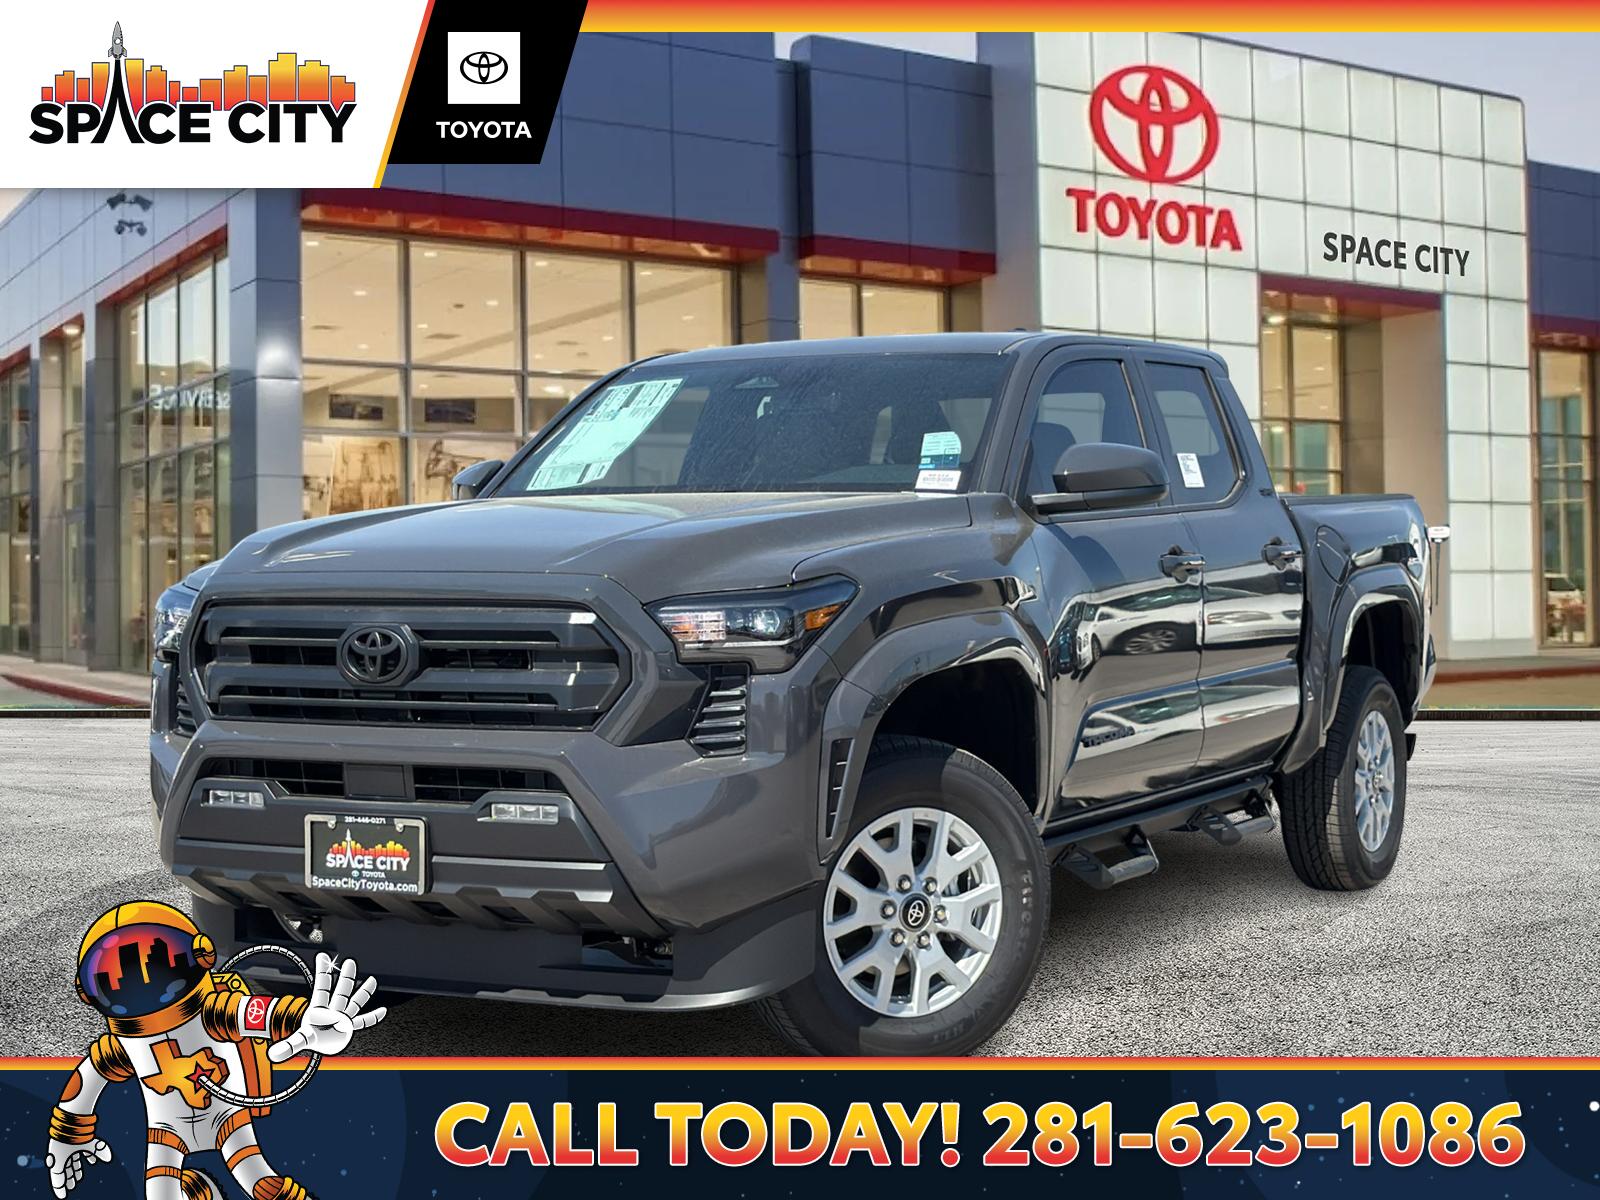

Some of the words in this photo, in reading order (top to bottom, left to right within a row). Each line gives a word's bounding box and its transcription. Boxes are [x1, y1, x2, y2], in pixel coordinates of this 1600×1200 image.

[1066, 188, 1242, 251] TOYOTA
[1323, 232, 1407, 270] SPACE
[1414, 245, 1470, 276] CITY
[326, 841, 374, 869] SPACE
[376, 856, 410, 872] CITY
[312, 875, 418, 892] SpaceCityToyota.com
[361, 870, 386, 879] TOYOTA
